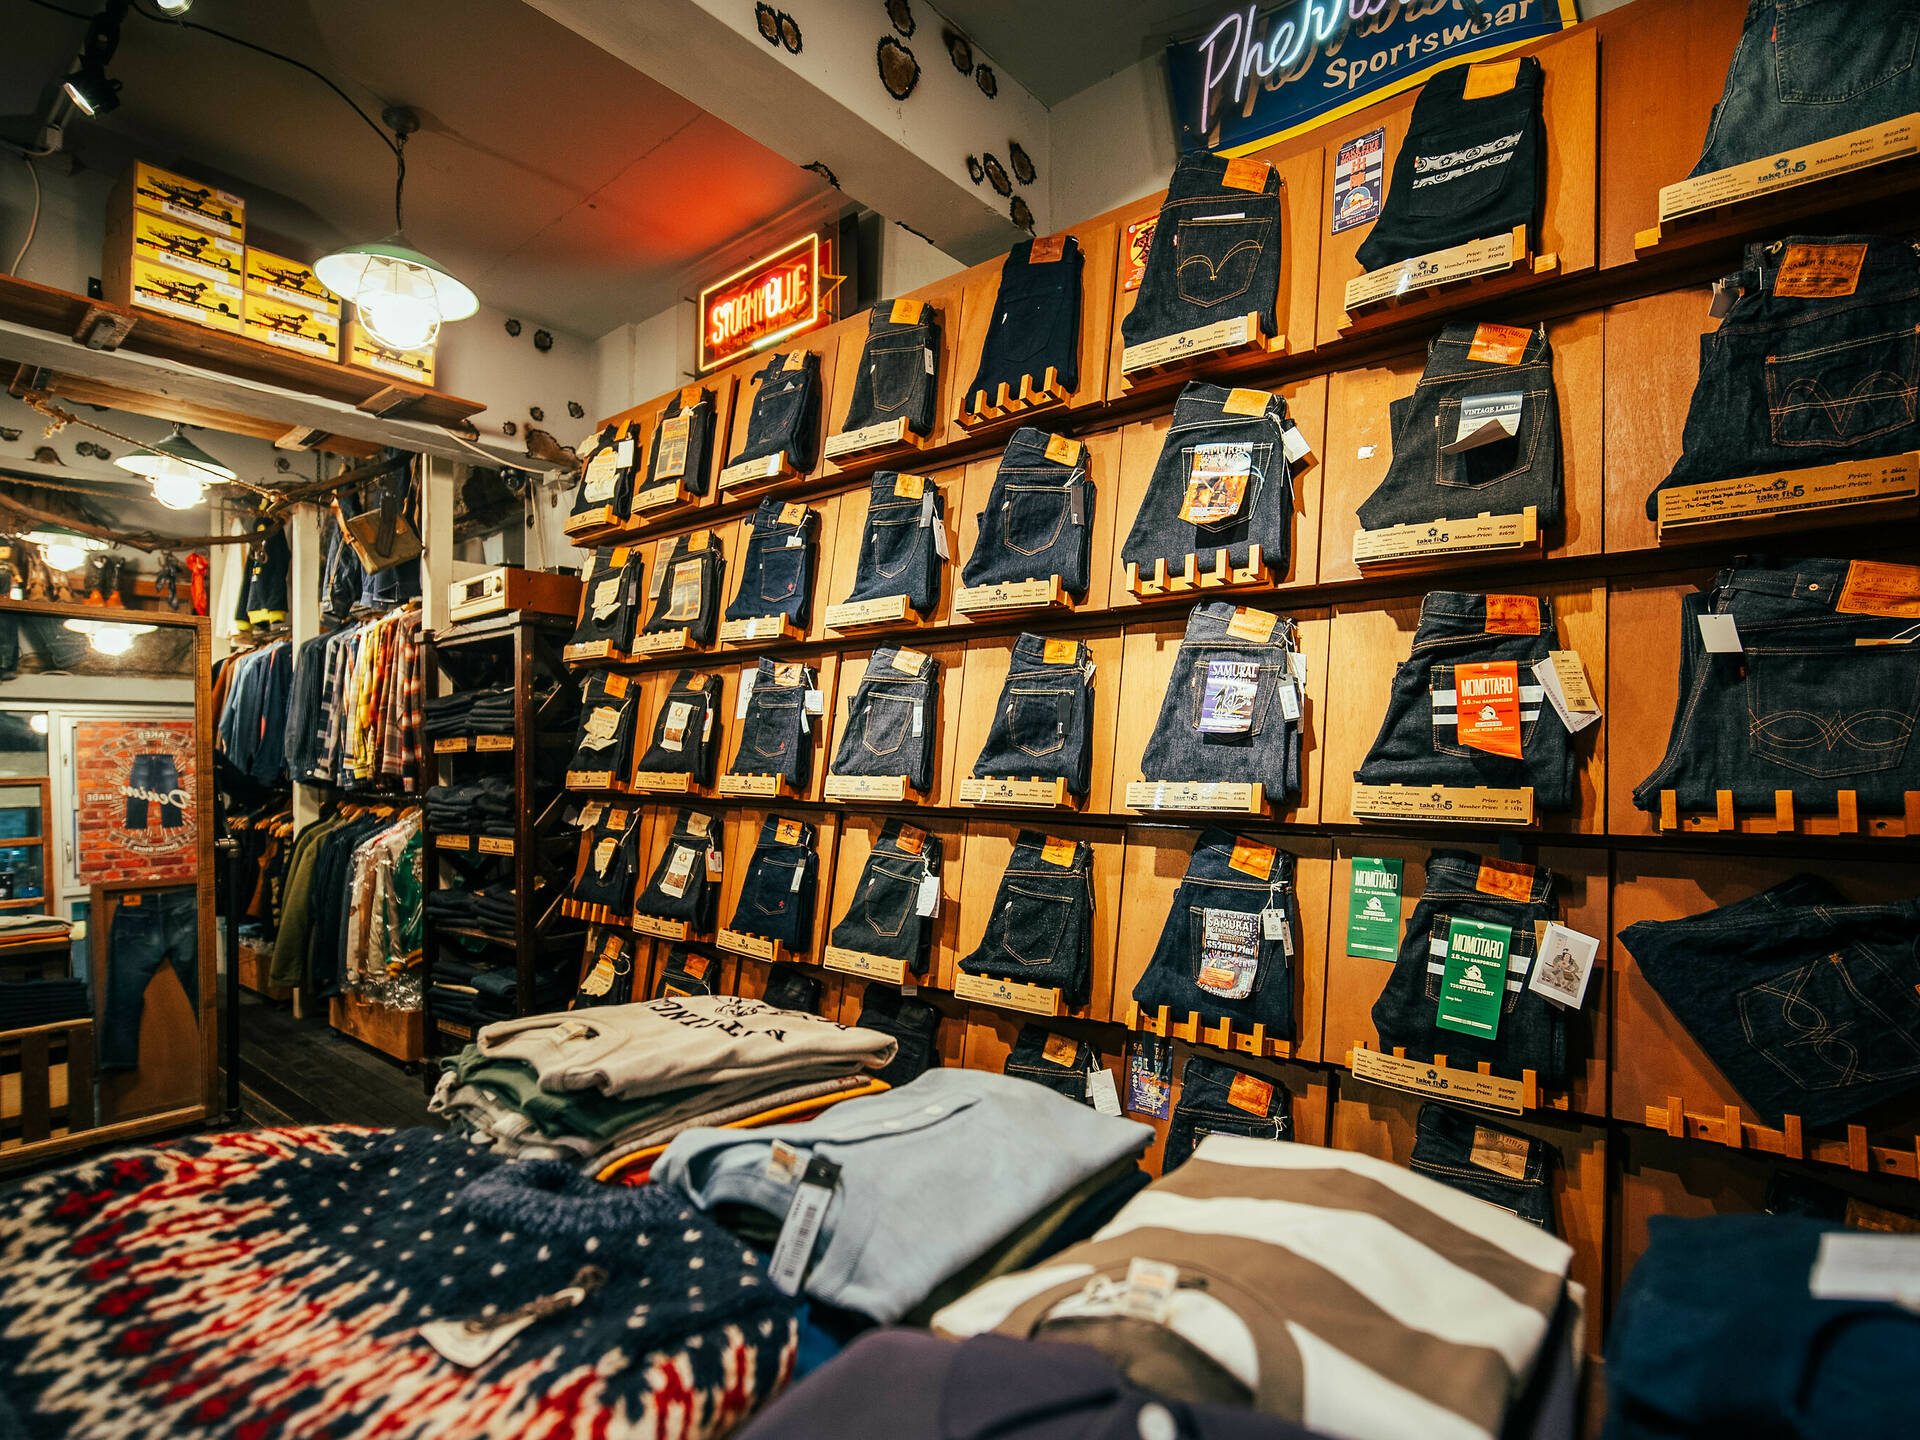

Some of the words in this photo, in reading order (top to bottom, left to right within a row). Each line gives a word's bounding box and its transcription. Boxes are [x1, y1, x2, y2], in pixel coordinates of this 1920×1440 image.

[1323, 0, 1535, 89] Sportswear
[1815, 152, 1846, 165] Member
[1848, 144, 1874, 156] Price:
[1757, 170, 1781, 182] take
[1464, 406, 1494, 416] VINTAGE
[1495, 404, 1518, 413] LABEL
[1847, 470, 1872, 480] Price:
[1695, 484, 1735, 495] Warehouse
[1813, 482, 1846, 493] Member
[1848, 478, 1873, 488] Price:
[1756, 491, 1779, 501] take
[1212, 664, 1257, 678] SAMURAI
[1461, 677, 1513, 697] MOMOTARO
[1355, 870, 1398, 889] MOMOTARO
[1208, 919, 1252, 932] SAMURAI
[1452, 933, 1504, 959] MOMOTARO
[1450, 983, 1466, 991] TIGHT
[1467, 987, 1494, 996] STRAIGHT
[1400, 1062, 1415, 1070] Jeans
[1415, 1076, 1431, 1086] take
[1476, 1082, 1492, 1090] Price:
[1453, 1084, 1475, 1093] Member
[1476, 1089, 1492, 1097] Price:
